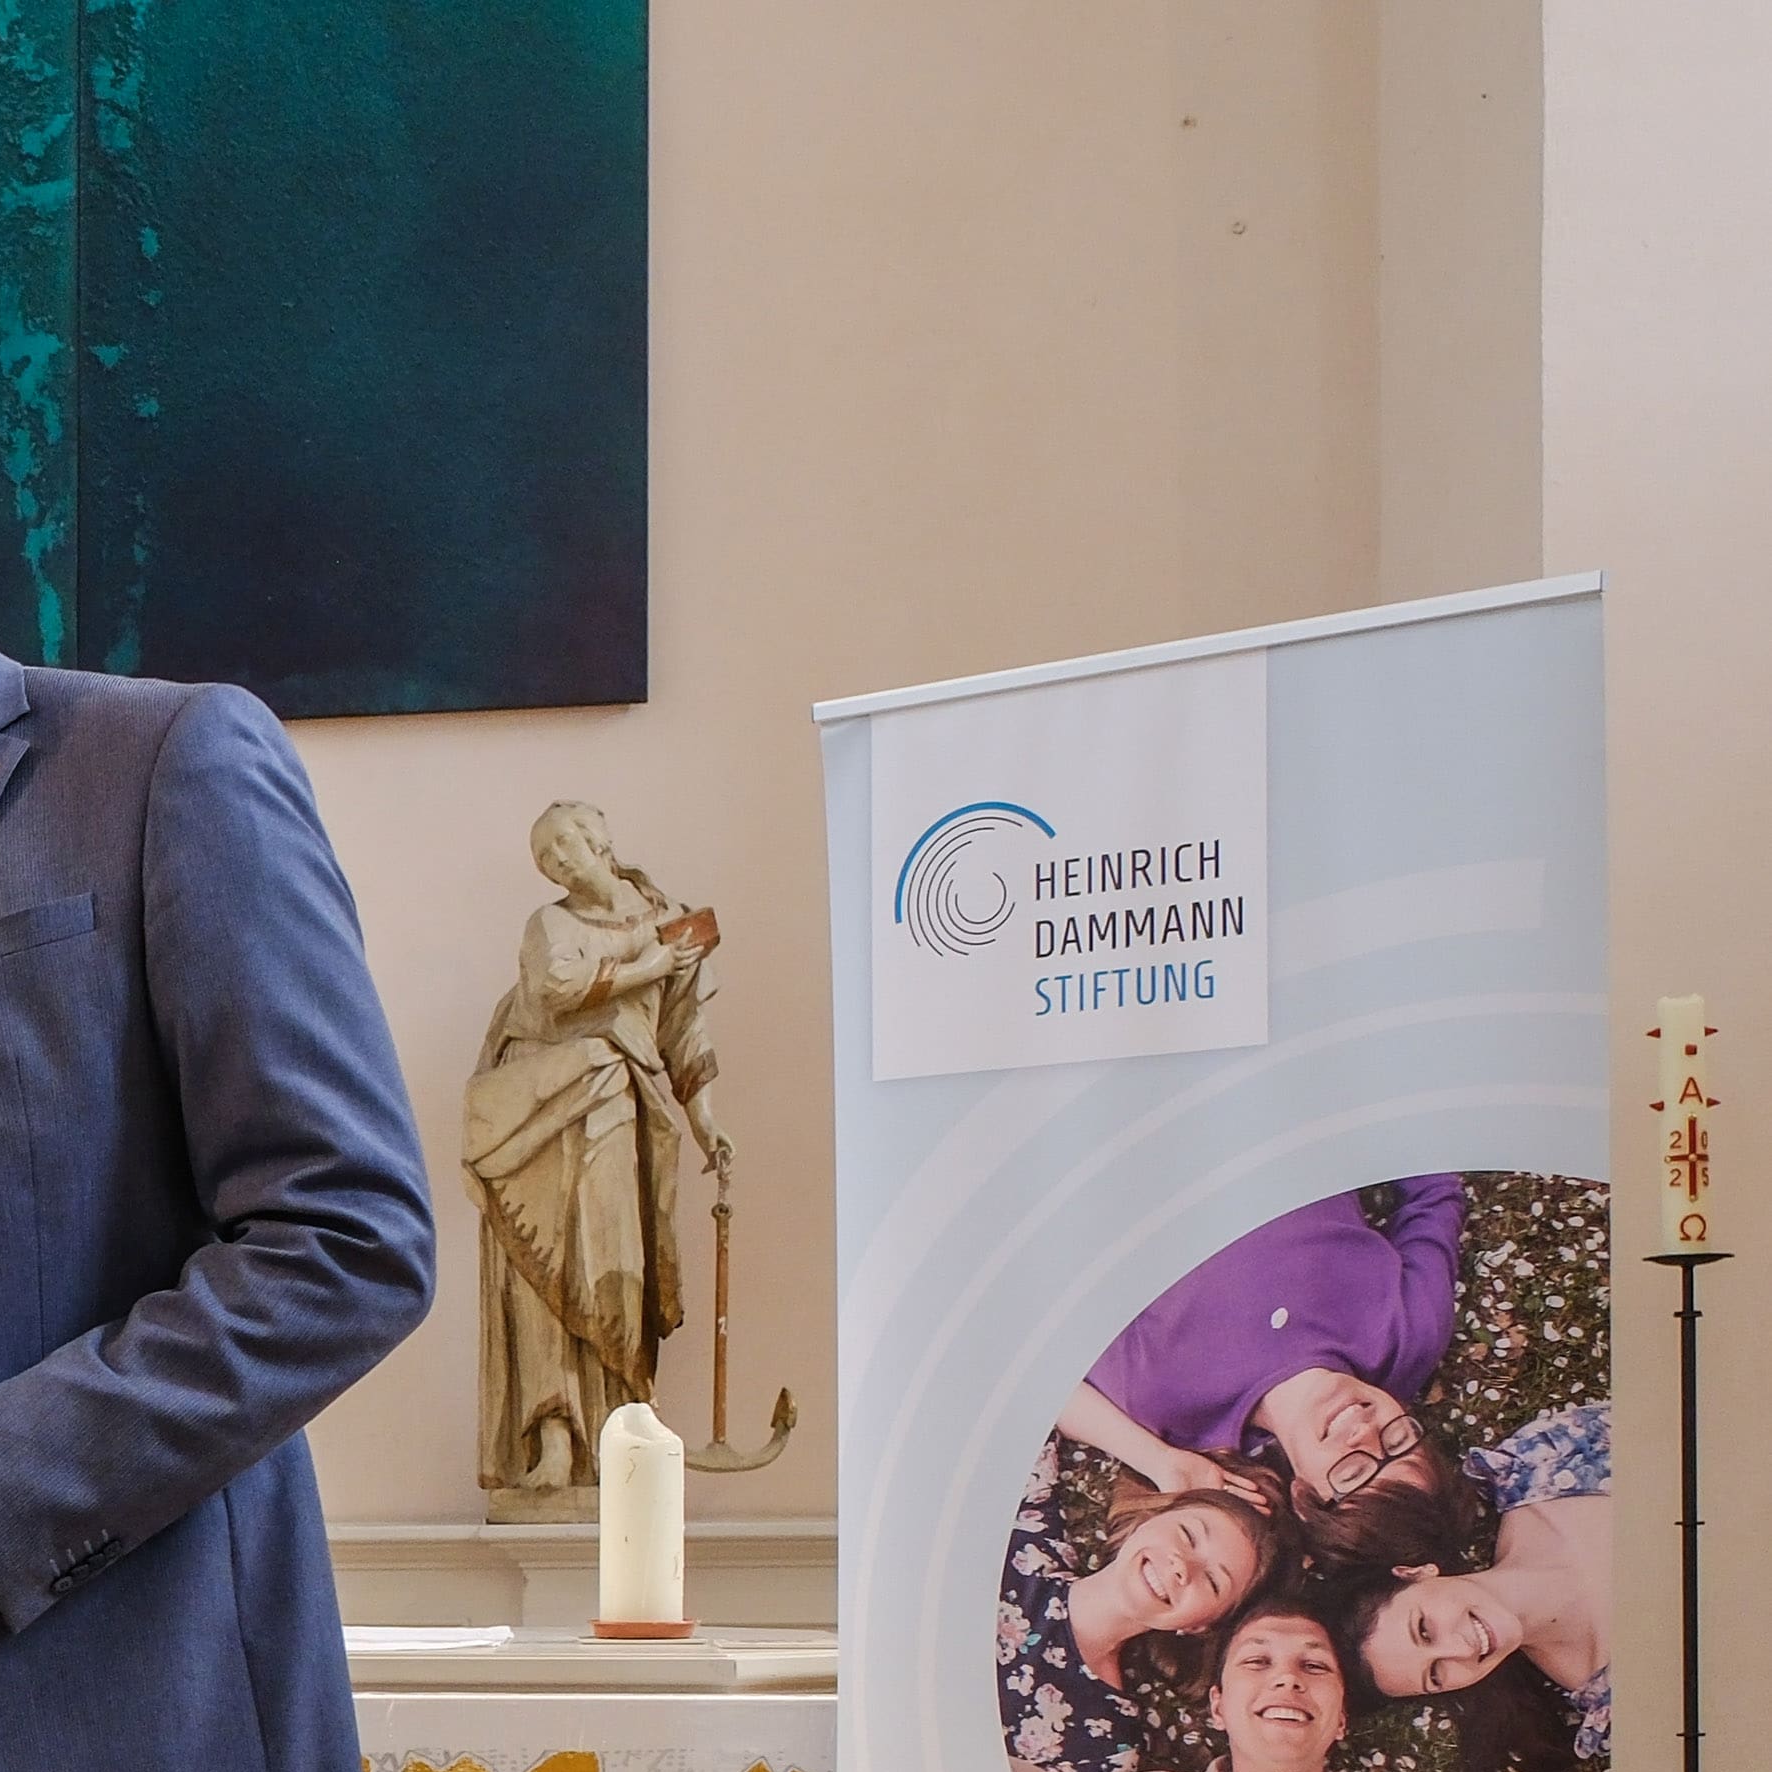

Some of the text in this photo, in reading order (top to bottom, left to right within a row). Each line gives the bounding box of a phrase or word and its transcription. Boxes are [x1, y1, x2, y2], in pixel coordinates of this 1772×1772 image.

[1035, 839, 1220, 901] HEINRICH
[1035, 896, 1244, 959] DAMMANN
[1035, 960, 1215, 1016] STIFTUNG
